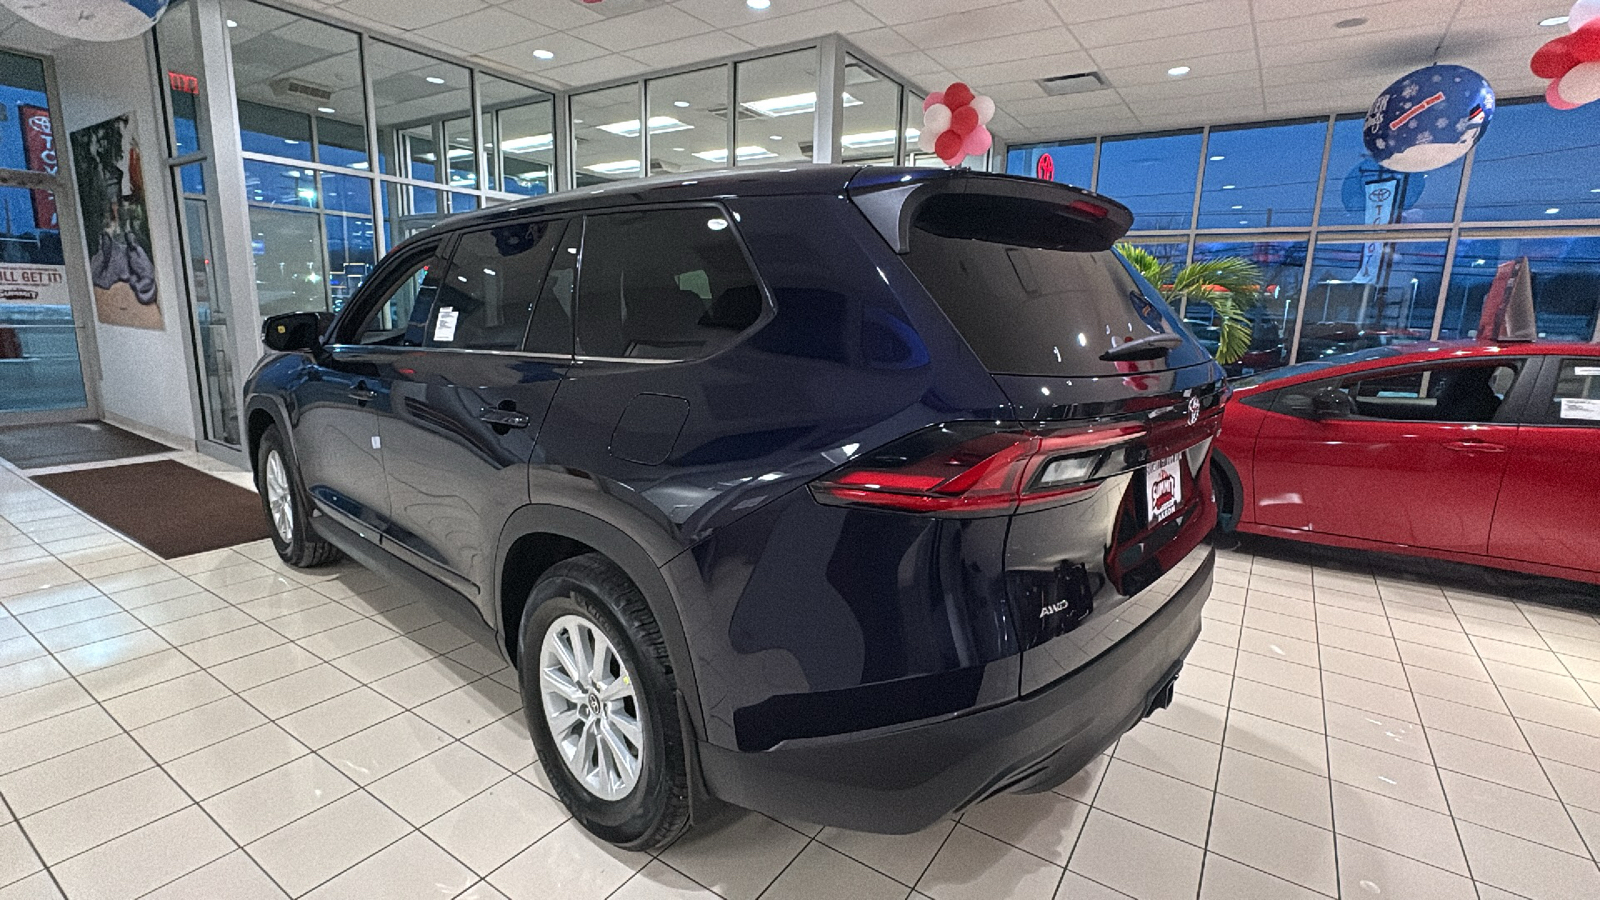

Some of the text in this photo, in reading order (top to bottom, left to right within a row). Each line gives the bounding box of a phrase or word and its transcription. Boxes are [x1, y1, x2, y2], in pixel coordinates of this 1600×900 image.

[21, 271, 42, 282] GET
[47, 272, 62, 284] IT!
[1040, 600, 1068, 618] AWD
